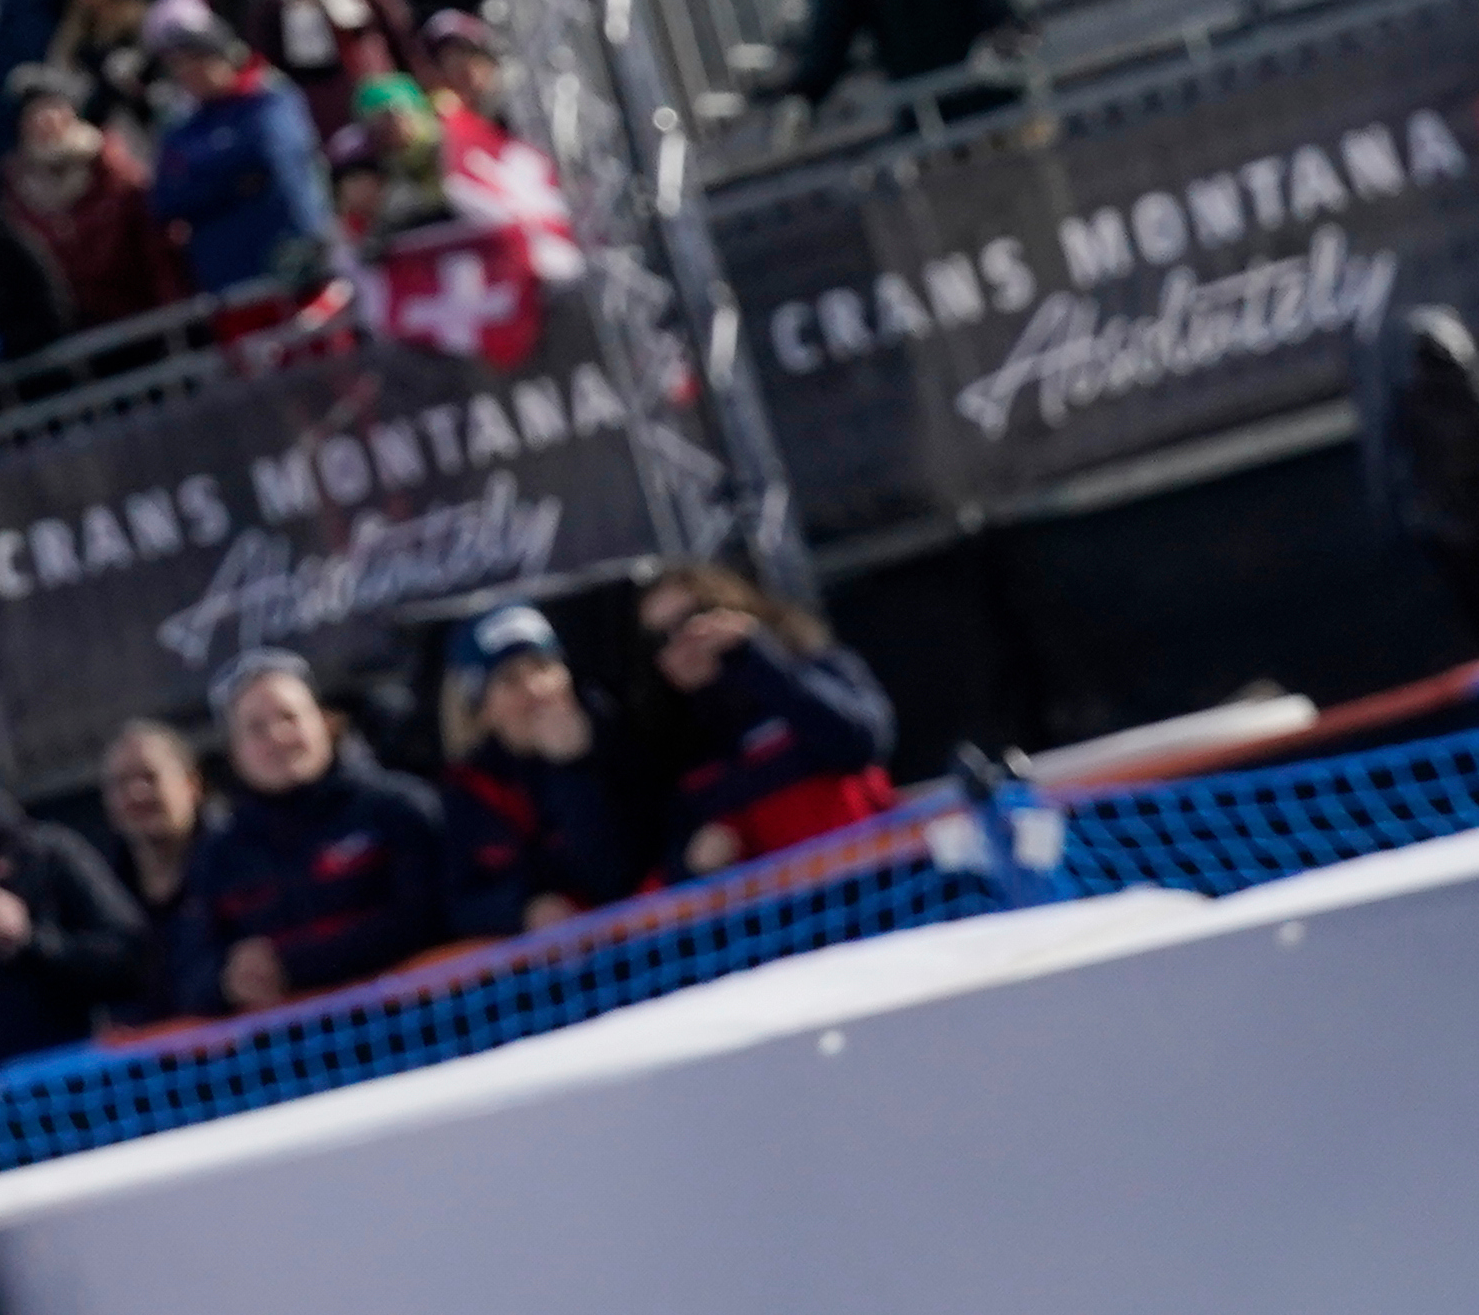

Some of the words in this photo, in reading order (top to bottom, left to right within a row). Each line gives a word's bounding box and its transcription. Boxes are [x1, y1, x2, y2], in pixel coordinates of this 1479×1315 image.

[769, 236, 1036, 371] CRANS
[1059, 109, 1465, 289] MONTANA
[250, 362, 626, 524] MONTANA
